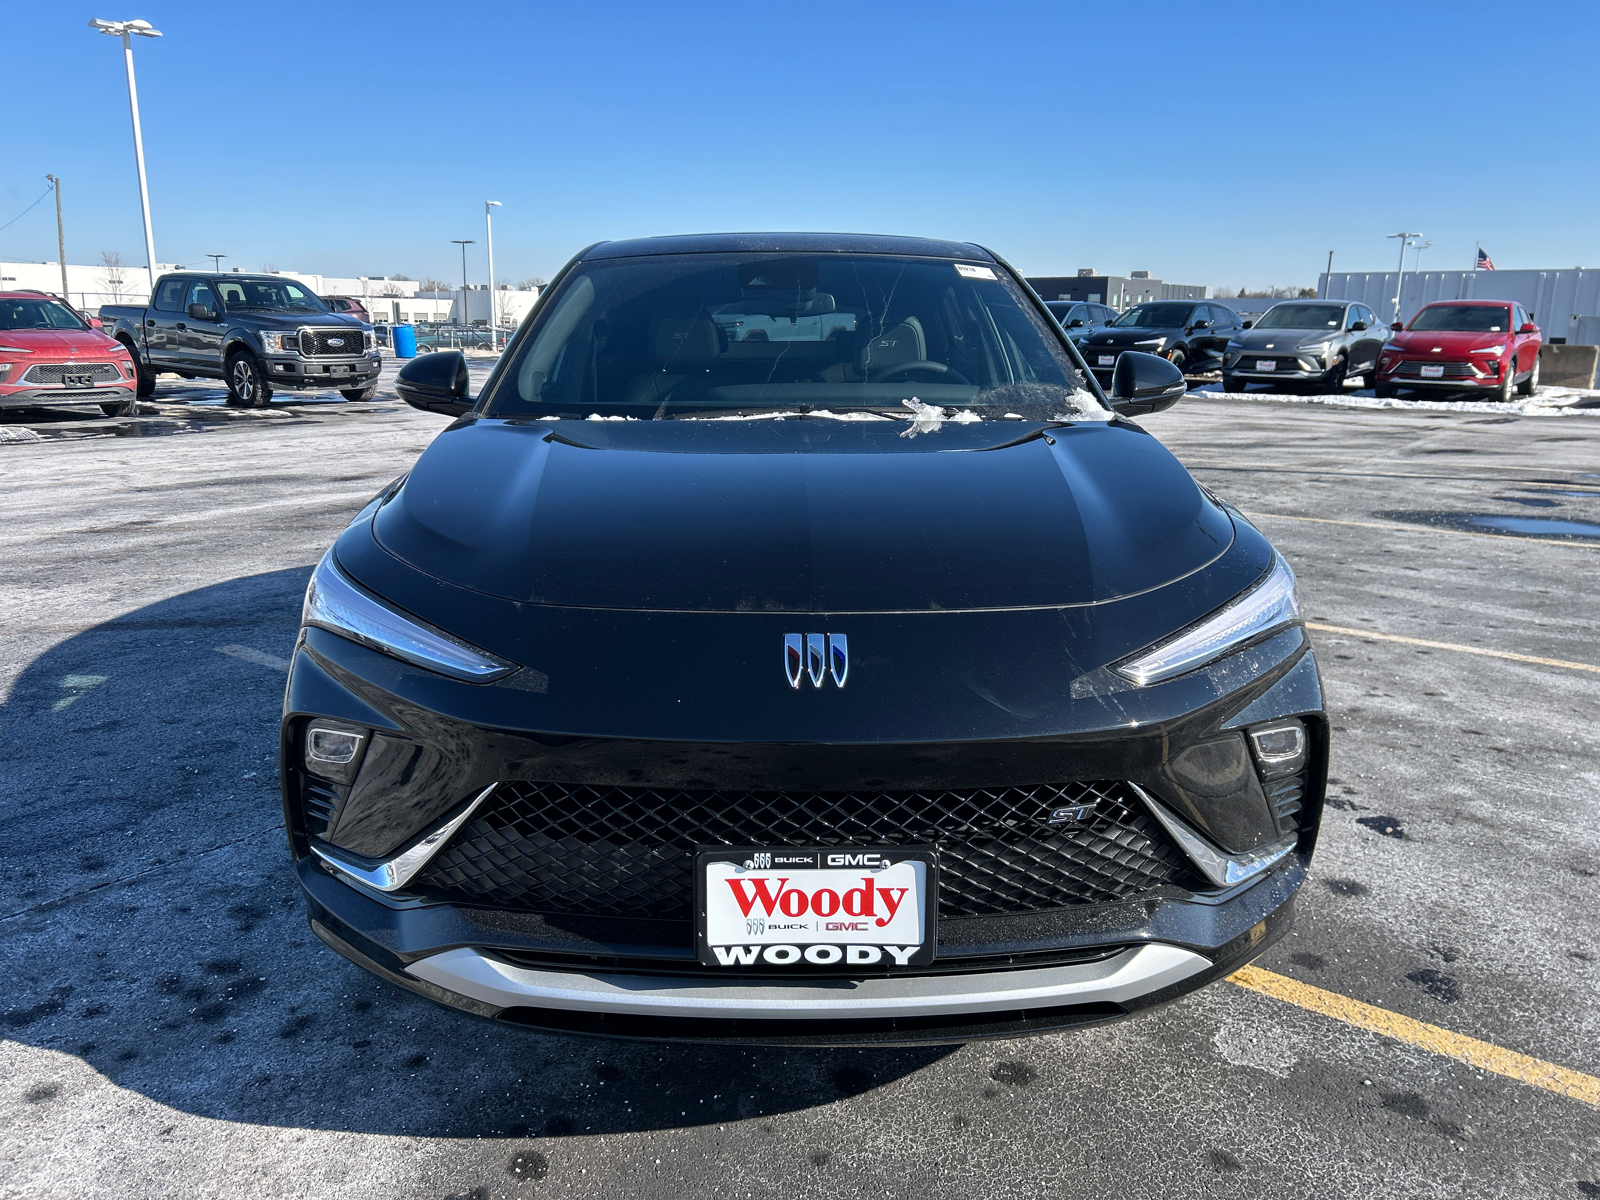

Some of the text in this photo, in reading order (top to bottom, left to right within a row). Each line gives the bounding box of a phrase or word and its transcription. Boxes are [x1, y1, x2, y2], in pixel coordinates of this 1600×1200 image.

[879, 339, 900, 347] ST
[1048, 803, 1097, 824] ST
[827, 853, 881, 866] GMC
[724, 877, 909, 927] Woody
[825, 922, 868, 931] GMC
[712, 944, 921, 965] WOODY
